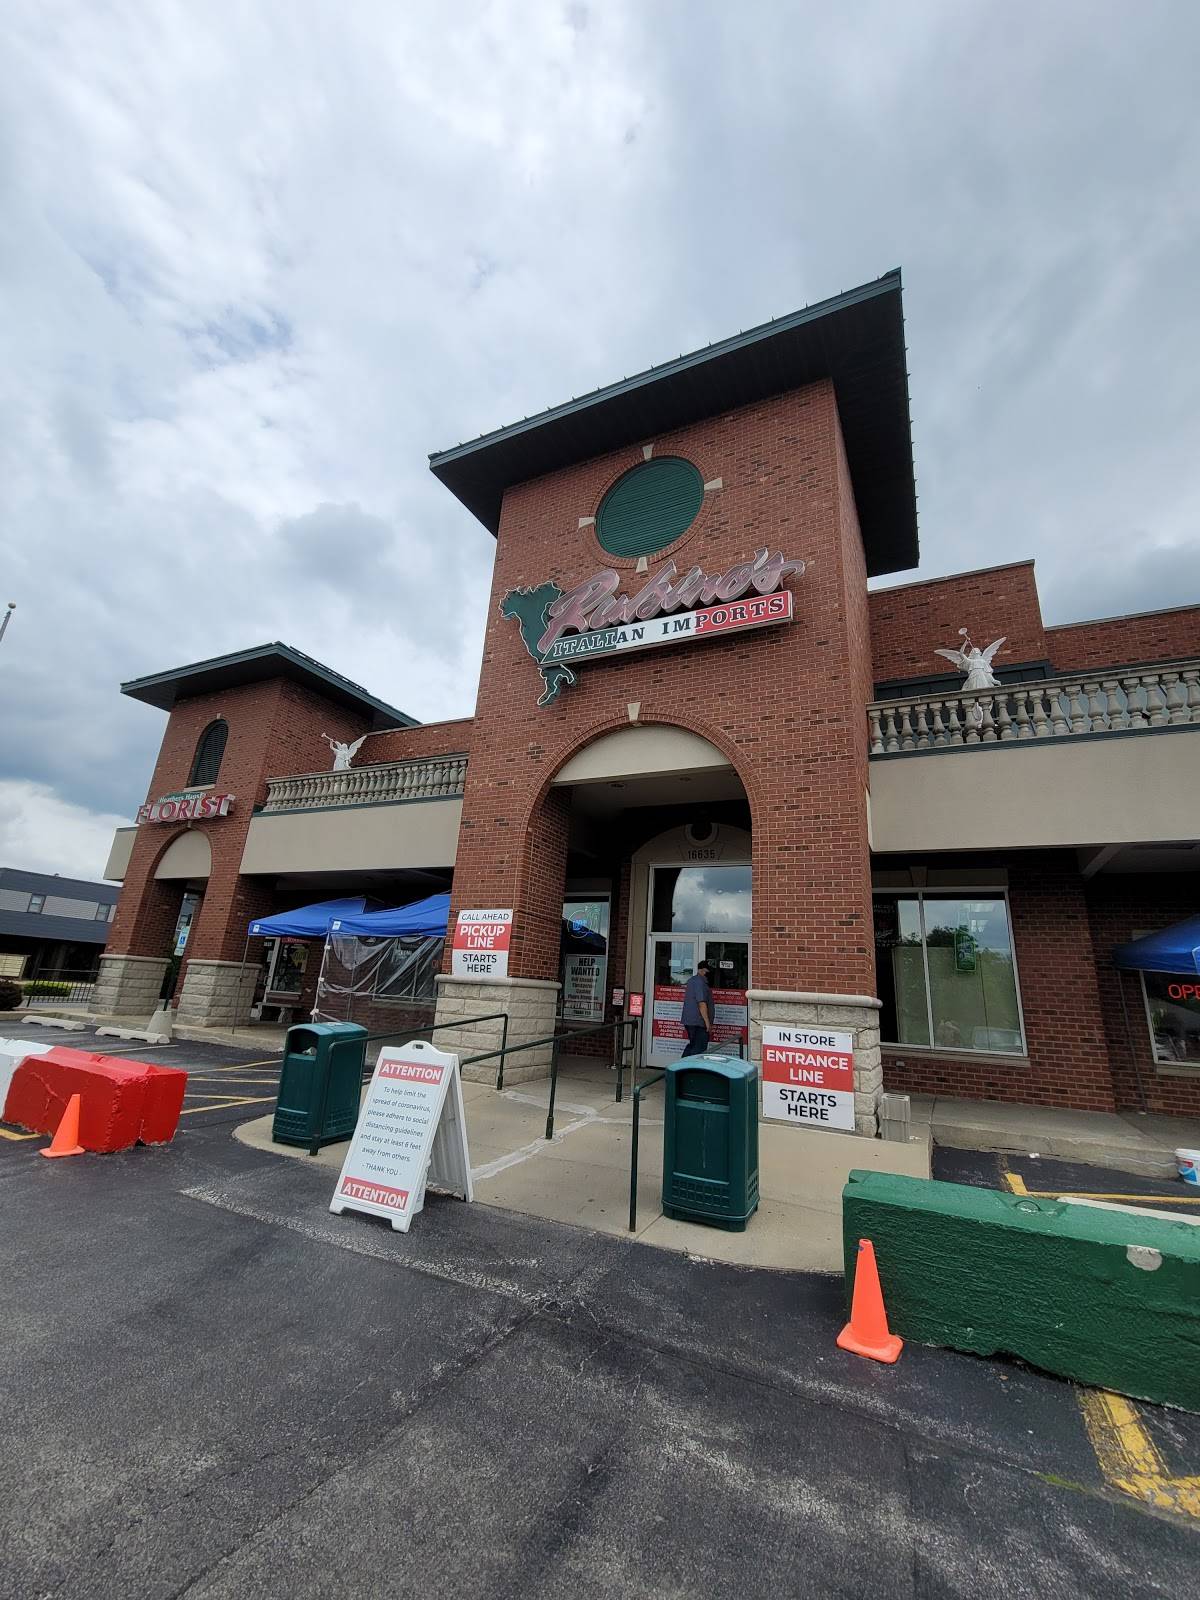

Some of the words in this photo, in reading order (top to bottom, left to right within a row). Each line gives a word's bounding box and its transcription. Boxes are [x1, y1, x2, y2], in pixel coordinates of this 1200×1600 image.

[537, 547, 805, 653] Rubino's
[553, 627, 645, 657] ITALIAN
[662, 597, 785, 635] IMPORTS
[134, 793, 234, 824] FLORIST
[688, 849, 715, 860] 16635
[461, 913, 480, 921] CALL
[460, 925, 506, 937] PICKUP
[467, 936, 495, 948] LINE
[462, 953, 497, 963] STARTS
[578, 957, 595, 967] HELP
[467, 964, 492, 973] HERE
[779, 1032, 791, 1042] IN
[795, 1033, 836, 1047] STORE
[766, 1049, 849, 1070] ENTRANCE
[381, 1063, 442, 1080] ATTENTION
[789, 1068, 824, 1084] LINE
[391, 1087, 403, 1096] help
[403, 1089, 416, 1097] limit
[779, 1089, 837, 1107] STARTS
[372, 1098, 390, 1106] spread
[398, 1101, 431, 1113] coronavirus,
[787, 1103, 829, 1120] HERE
[368, 1110, 385, 1118] please
[385, 1111, 405, 1121] adhere
[412, 1116, 429, 1125] social
[365, 1121, 394, 1133] distancing
[394, 1126, 423, 1137] guidelines
[371, 1135, 383, 1144] stay
[391, 1138, 404, 1147] least
[409, 1142, 421, 1150] feet
[361, 1147, 377, 1157] away
[377, 1150, 390, 1158] from
[366, 1163, 385, 1173] THANK
[386, 1168, 399, 1176] YOU
[343, 1182, 406, 1208] ATTENTION
